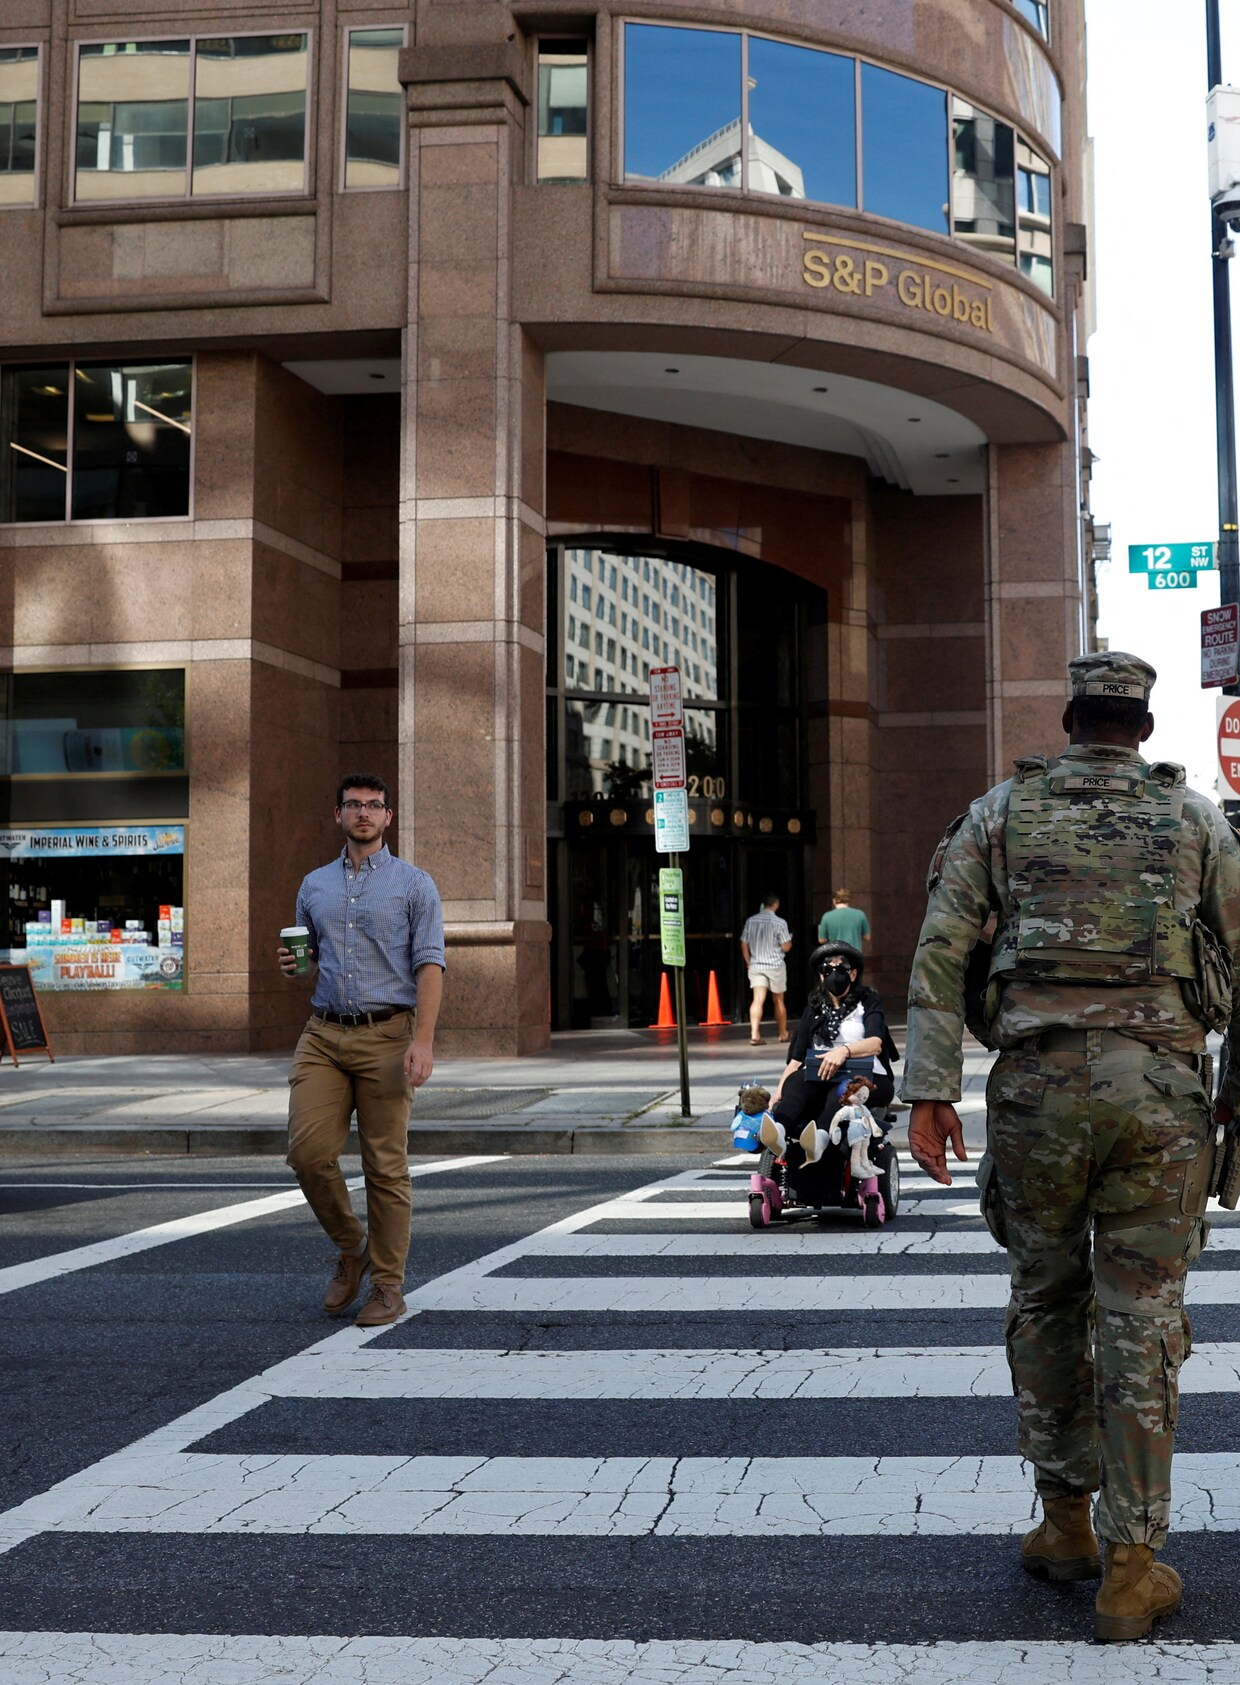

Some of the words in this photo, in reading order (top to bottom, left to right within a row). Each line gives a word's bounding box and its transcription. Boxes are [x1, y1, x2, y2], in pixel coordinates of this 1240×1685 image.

[803, 250, 889, 296] S&P
[898, 270, 993, 332] Global
[1142, 546, 1172, 570] 12
[1191, 546, 1208, 556] ST
[1190, 557, 1209, 567] NW
[1155, 572, 1190, 588] 600
[1207, 609, 1232, 624] SNOW
[1203, 621, 1235, 634] EMERGENCY
[1205, 631, 1234, 646] ROUTE
[1203, 649, 1211, 658] NO
[1214, 644, 1236, 656] PARKING
[1210, 656, 1230, 668] DURING
[1203, 667, 1235, 680] EMERGENCY
[1102, 684, 1129, 695] PRICE
[1225, 717, 1240, 733] DO
[1083, 778, 1110, 787] PRICE
[30, 836, 73, 849] IMPERIAL
[75, 834, 99, 848] WINE
[102, 835, 109, 848] &
[112, 834, 148, 847] SPIRITS
